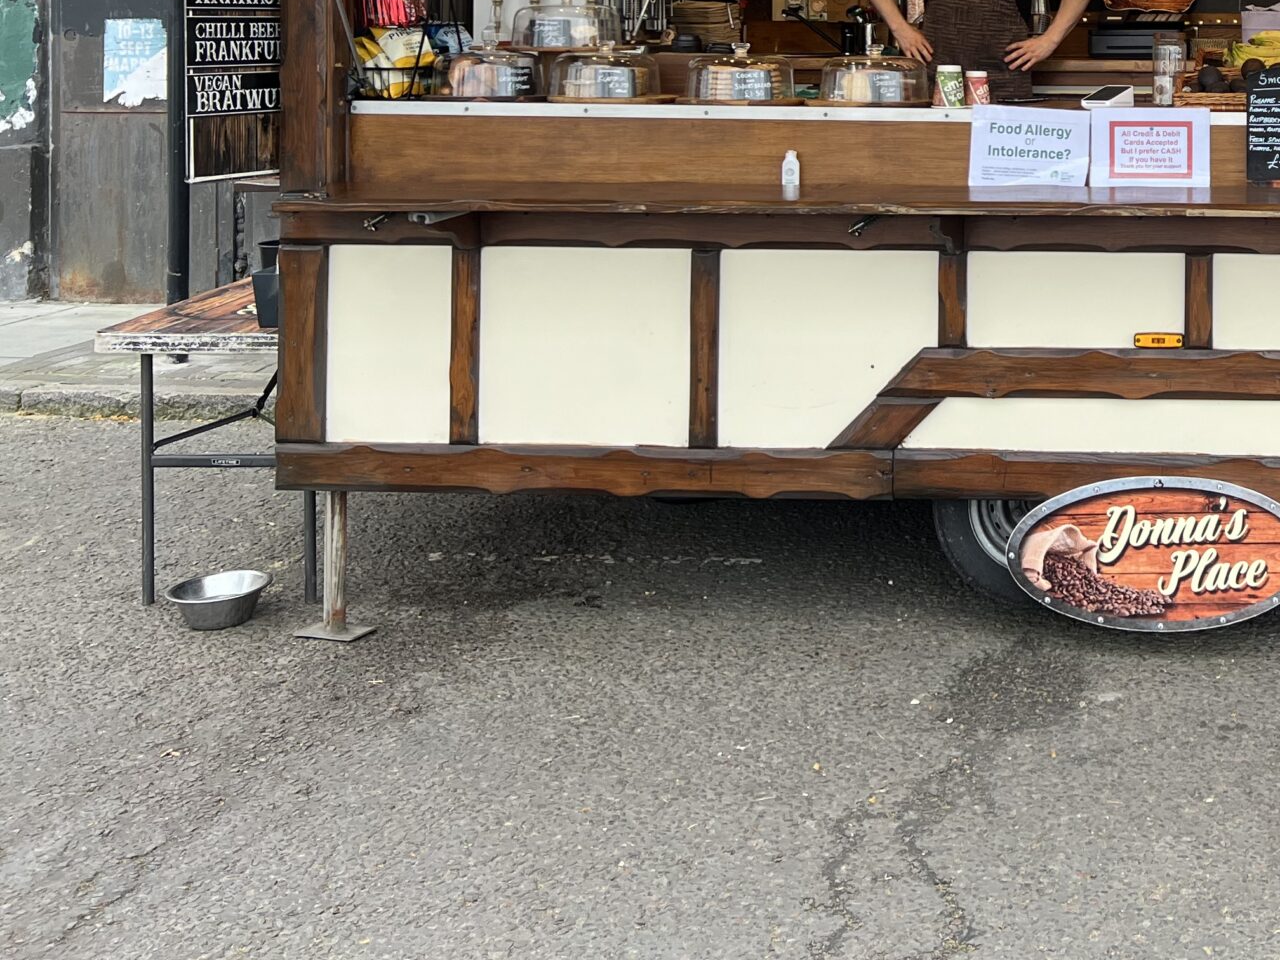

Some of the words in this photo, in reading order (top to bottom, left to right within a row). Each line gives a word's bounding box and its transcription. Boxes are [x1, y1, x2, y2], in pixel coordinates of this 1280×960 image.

[196, 23, 245, 38] CHILLI
[194, 75, 242, 90] VEGAN
[990, 122, 1022, 134] Food
[1025, 124, 1072, 140] Allergy
[988, 145, 1071, 160] Intolerance?
[1095, 495, 1248, 564] Donna's
[1158, 547, 1269, 596] Place
